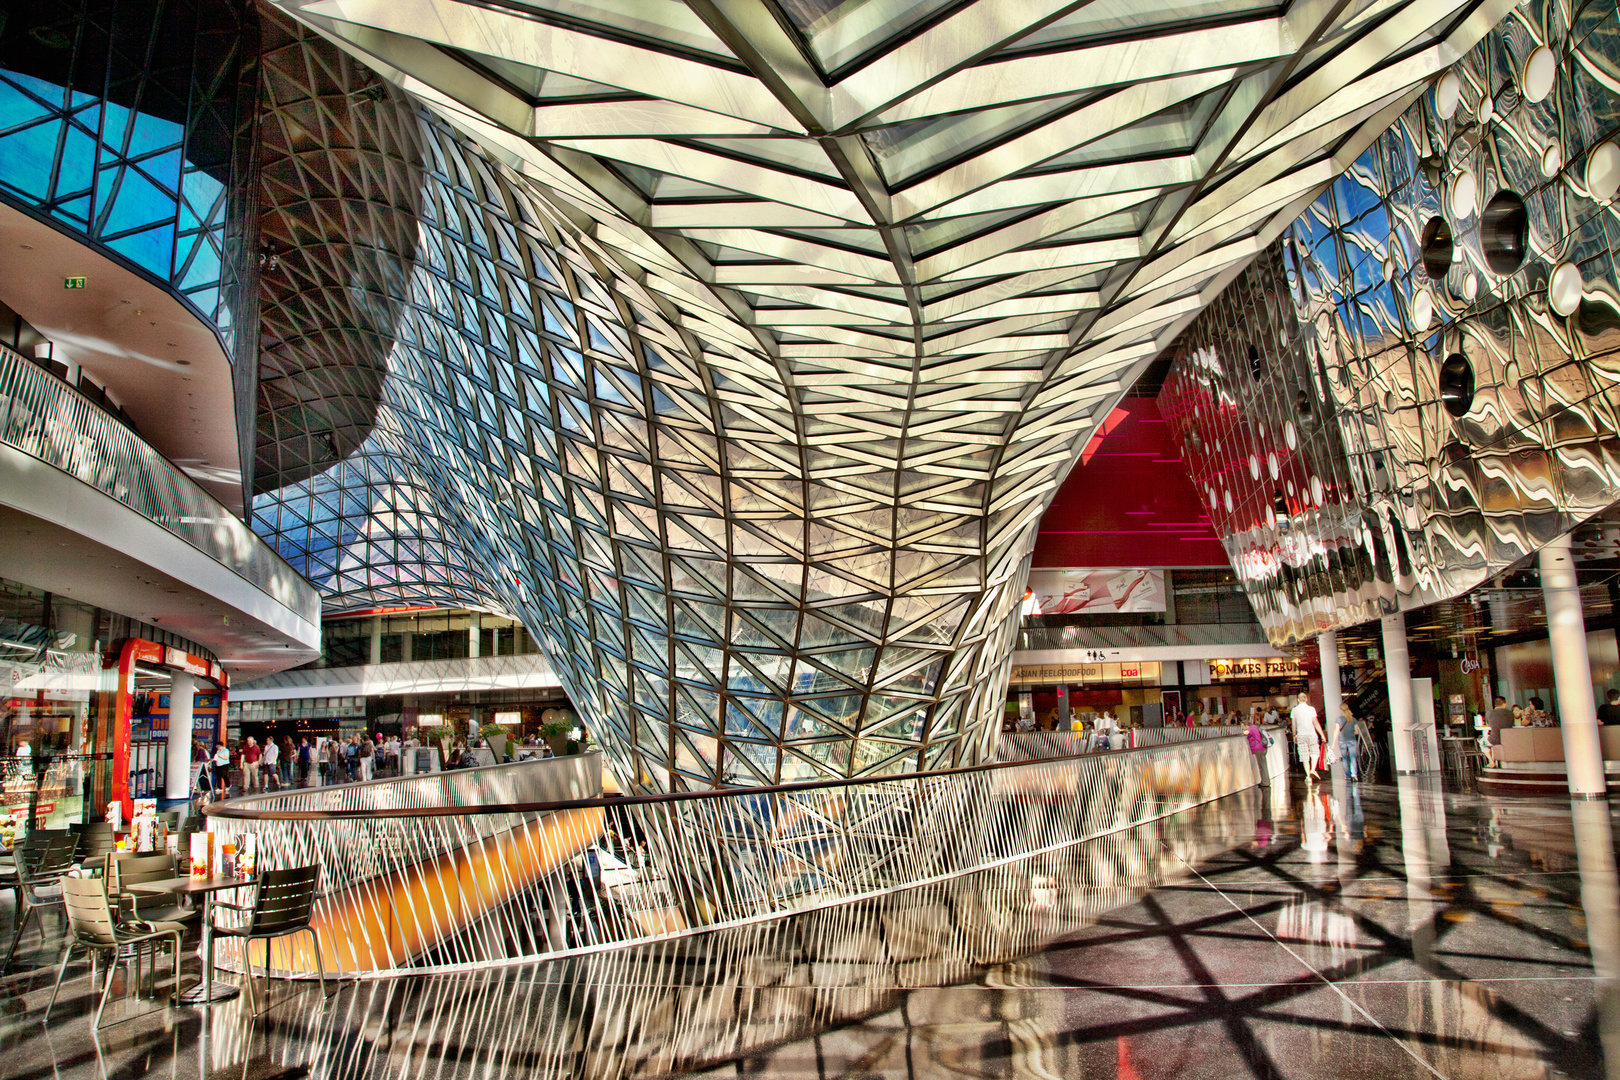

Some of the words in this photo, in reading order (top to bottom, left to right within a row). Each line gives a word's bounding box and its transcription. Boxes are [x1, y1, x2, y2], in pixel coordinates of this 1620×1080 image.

[1015, 670, 1037, 678] ASIAN
[1040, 668, 1096, 677] FEELGOODFOOD
[1121, 669, 1138, 677] coa
[1209, 663, 1261, 675] POMMES
[1266, 661, 1301, 673] FREUN
